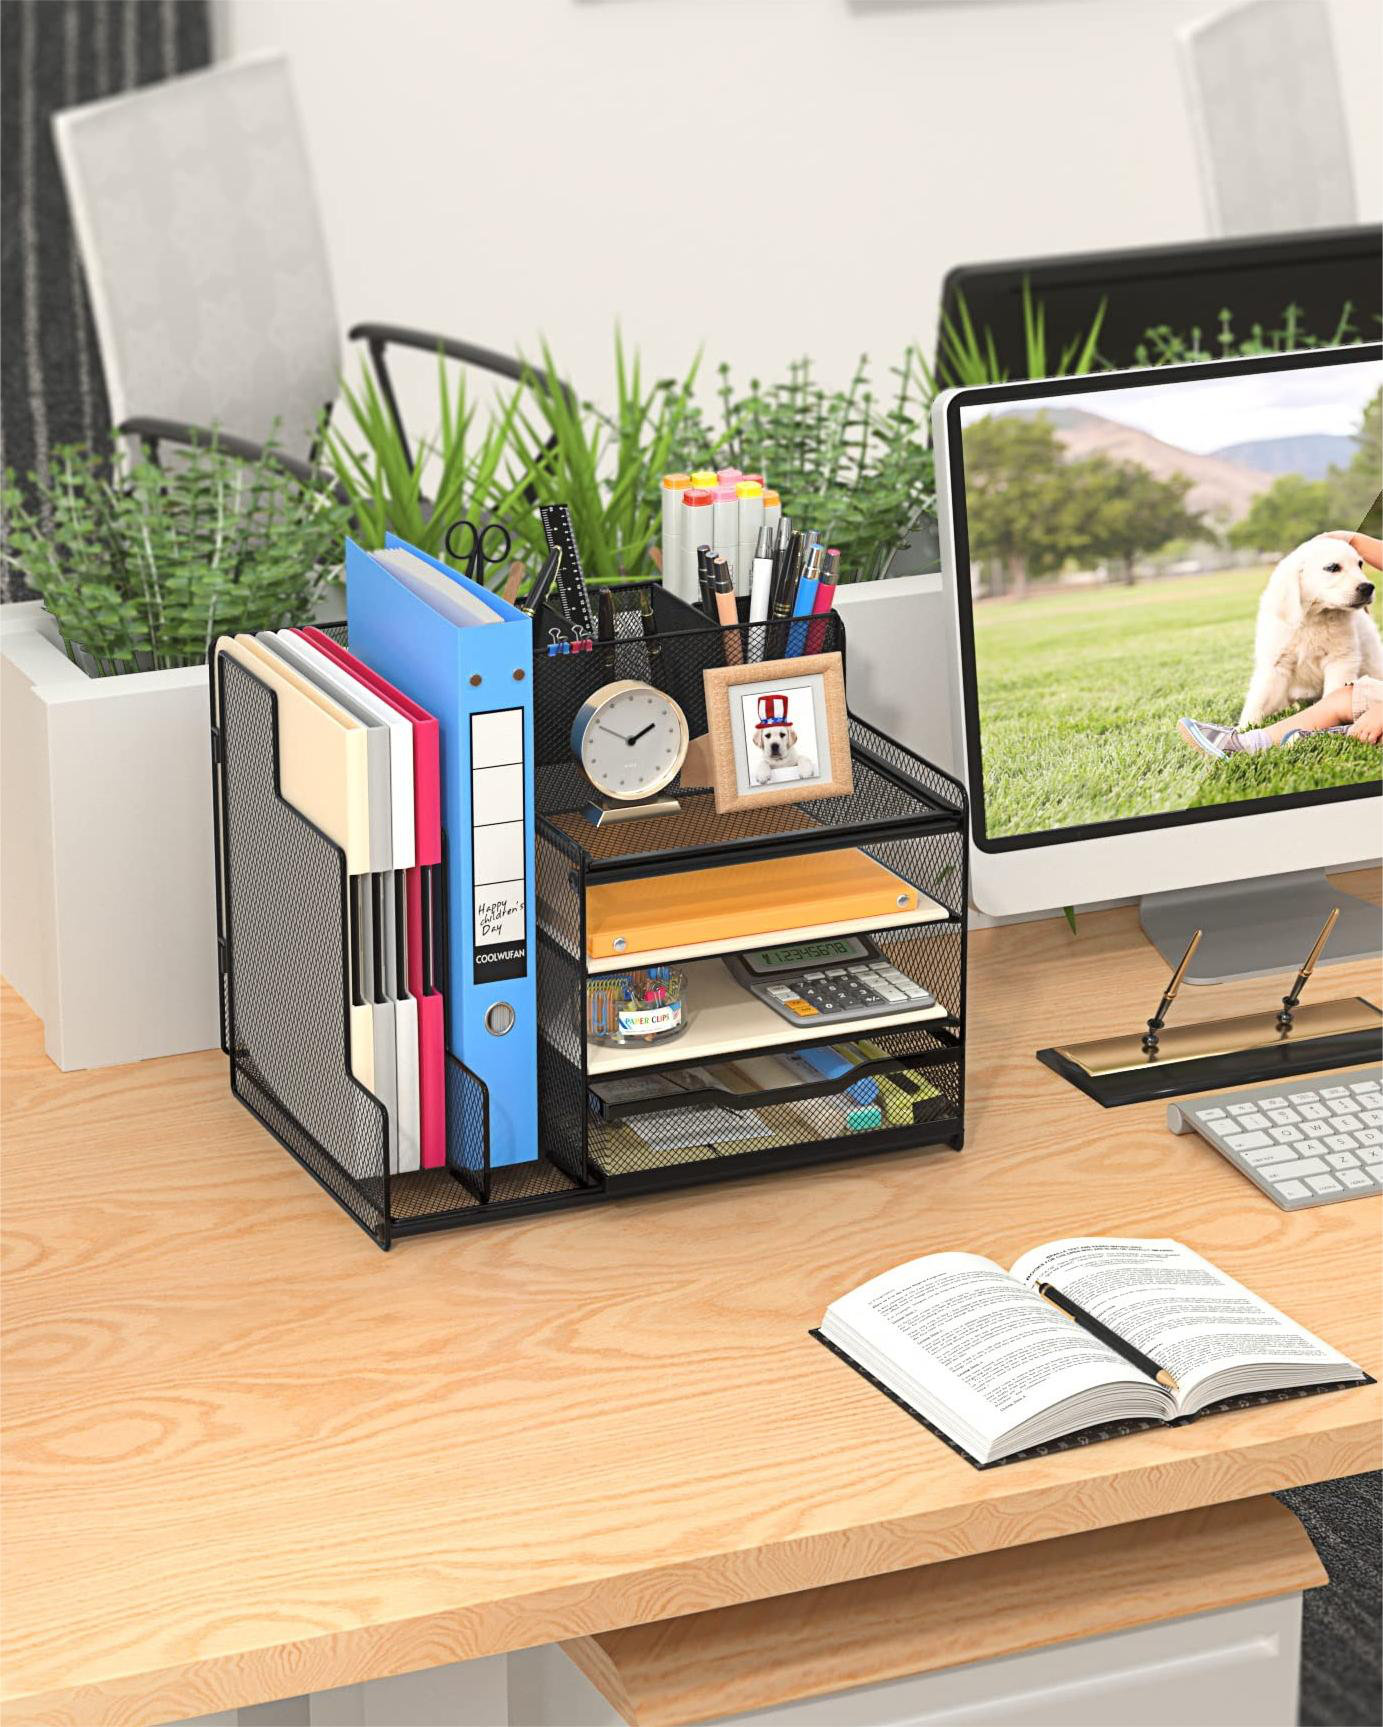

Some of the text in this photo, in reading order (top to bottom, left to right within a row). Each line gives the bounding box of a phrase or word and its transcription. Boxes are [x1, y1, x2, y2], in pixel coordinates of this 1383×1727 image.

[478, 900, 507, 916] Happy
[480, 901, 525, 926] children's
[482, 923, 502, 936] Day
[476, 949, 525, 964] COOLWUFAN
[625, 1013, 670, 1025] PAPER CLIPS
